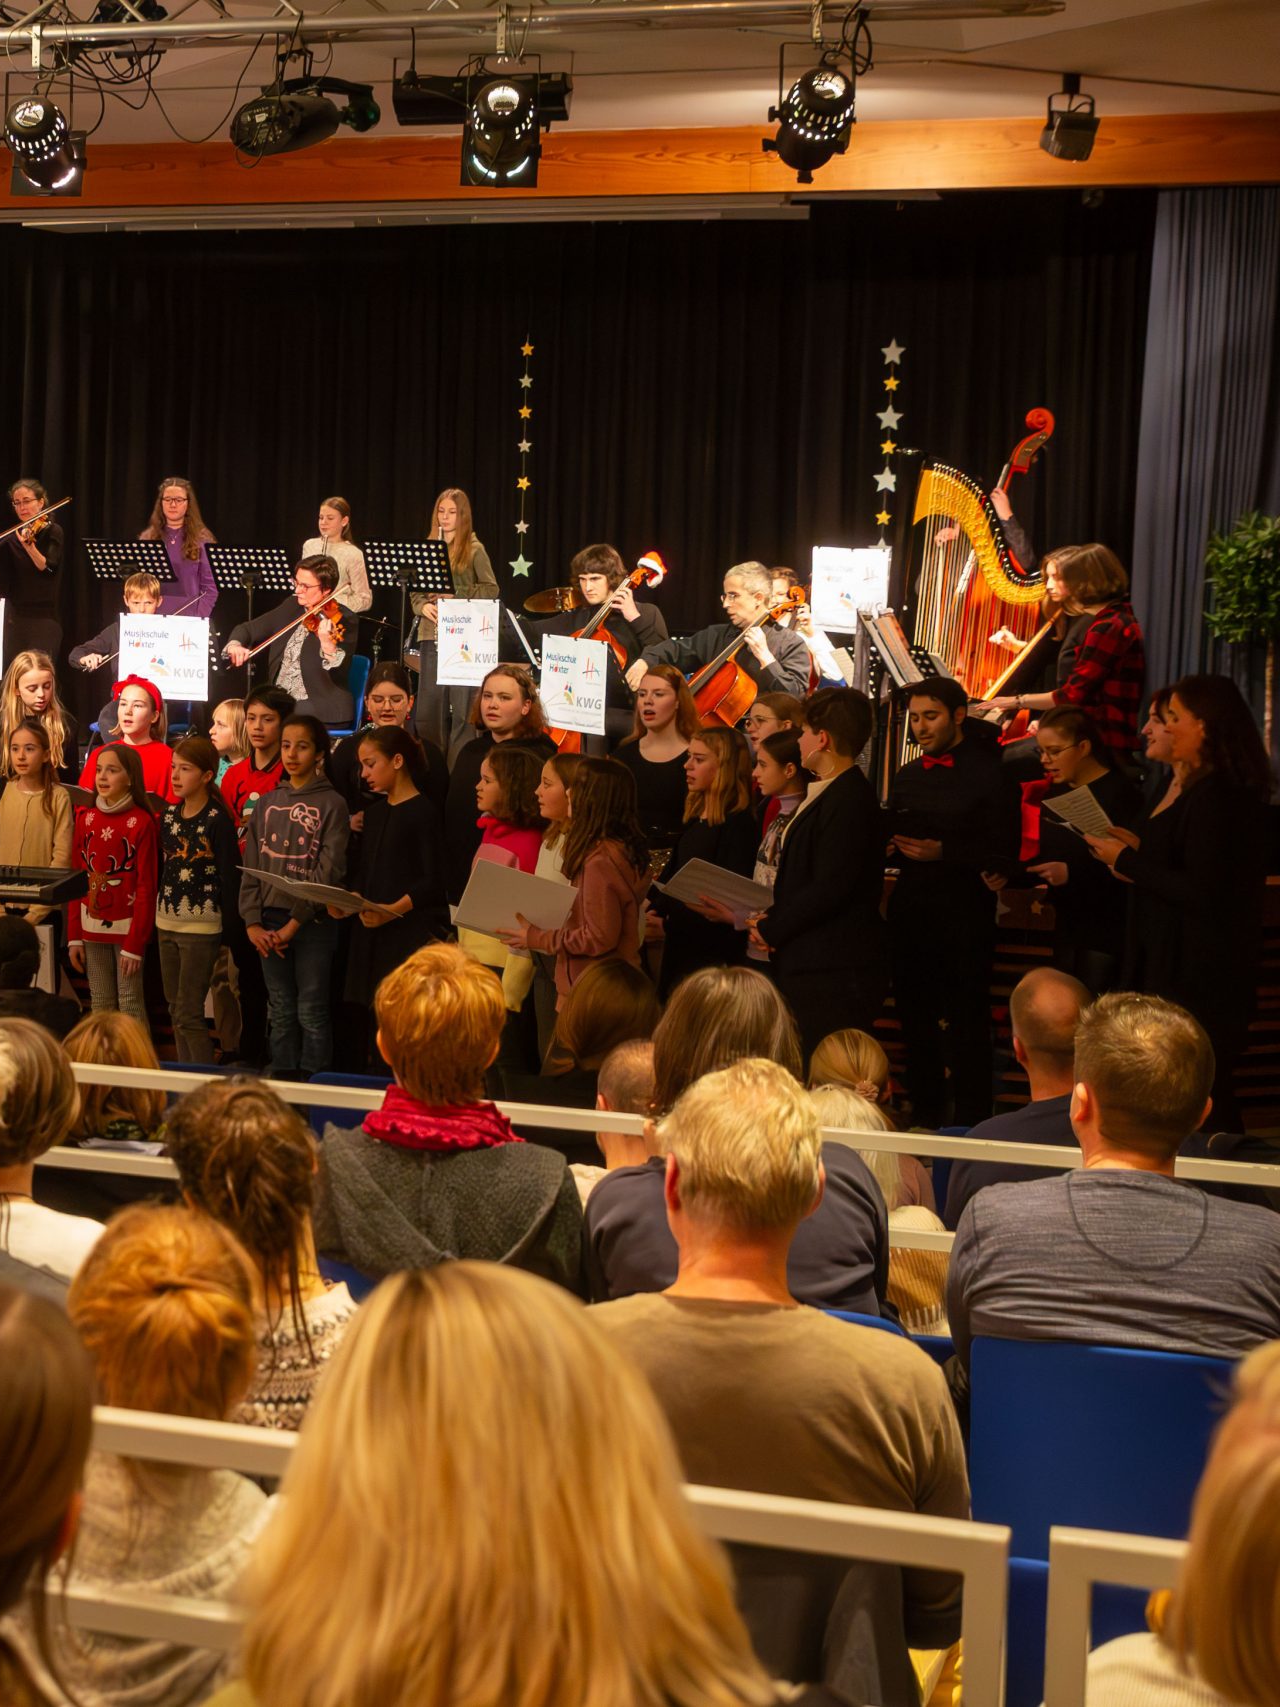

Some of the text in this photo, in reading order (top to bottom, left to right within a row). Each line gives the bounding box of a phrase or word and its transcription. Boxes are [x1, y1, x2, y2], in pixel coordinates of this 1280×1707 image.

[474, 653, 497, 664] KWG
[173, 667, 205, 679] KWG
[576, 696, 603, 710] KWG
